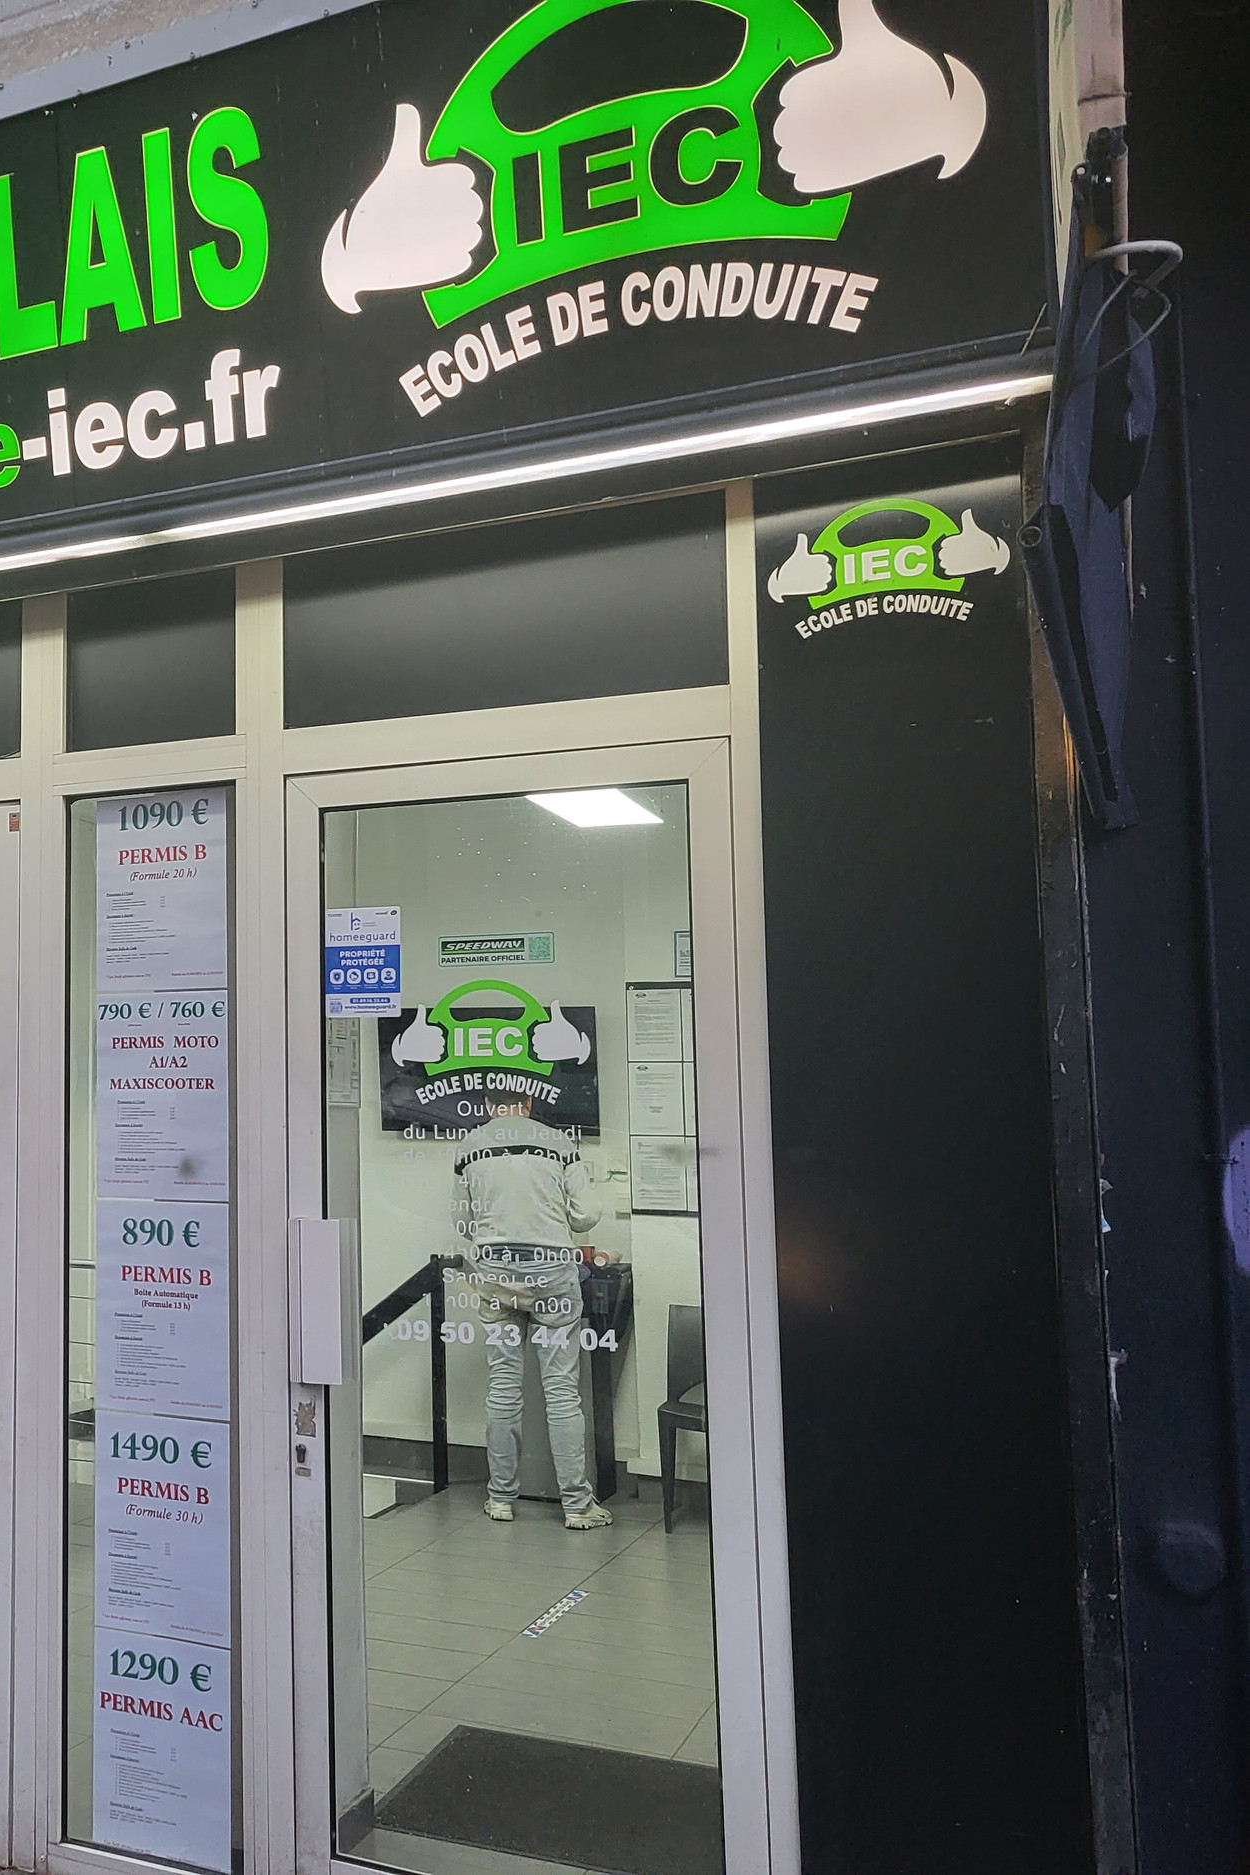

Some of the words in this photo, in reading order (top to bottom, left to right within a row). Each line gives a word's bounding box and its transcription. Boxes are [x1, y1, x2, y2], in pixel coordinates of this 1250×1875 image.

[512, 105, 743, 247] IEC
[398, 304, 543, 418] ECOLE
[546, 279, 609, 347] DE
[620, 262, 879, 333] CONDUITE
[843, 545, 928, 584] IEC
[794, 603, 854, 639] ECOLE
[856, 597, 878, 618] DE
[882, 594, 974, 622] CONDUITE
[118, 800, 183, 831] 1090
[191, 798, 209, 825] €
[118, 845, 188, 866] PERMIS
[195, 844, 207, 860] B
[130, 871, 170, 882] (Formule
[173, 869, 184, 879] 20
[186, 867, 197, 878] h)
[329, 930, 396, 943] homeeguard
[444, 940, 522, 951] SPEEDWAY
[340, 949, 386, 958] PROPRIÉTÉ
[341, 958, 385, 966] PROTÉGÉE
[441, 955, 489, 964] PARTENAIRE
[98, 1003, 132, 1020] 790
[138, 1002, 152, 1019] €
[170, 1001, 205, 1018] 760
[211, 1000, 226, 1018] €
[112, 1036, 164, 1049] PERMIS
[173, 1035, 219, 1048] MOTO
[453, 1026, 524, 1057] IEC
[149, 1055, 188, 1068] A1/A2
[110, 1078, 215, 1090] MAXISCOOTER
[415, 1075, 462, 1105] ECOLE
[465, 1073, 483, 1091] DE
[486, 1072, 562, 1105] CONDUITE
[457, 1100, 524, 1117] Ouvert
[403, 1125, 425, 1140] du
[434, 1124, 486, 1140] Lundi
[495, 1129, 519, 1140] au
[527, 1124, 582, 1140] Jeudi
[122, 1217, 174, 1246] 890
[182, 1220, 200, 1248] €
[121, 1265, 192, 1285] PERMIS
[199, 1269, 212, 1286] B
[153, 1289, 199, 1300] Automatique
[141, 1300, 173, 1310] (Formule
[174, 1301, 182, 1309] 13
[183, 1302, 191, 1311] h)
[398, 1319, 429, 1342] 09
[440, 1321, 475, 1344] 50
[485, 1323, 521, 1347] 23
[531, 1325, 570, 1349] 44
[580, 1328, 618, 1352] 04
[110, 1431, 180, 1464] 1490
[190, 1441, 212, 1469] €
[117, 1477, 189, 1502] PERMIS
[196, 1487, 210, 1505] B
[125, 1503, 172, 1520] (Formule
[175, 1510, 188, 1522] 30
[190, 1511, 204, 1525] h)
[109, 1648, 179, 1686] 1290
[189, 1663, 212, 1692] €
[99, 1690, 173, 1721] PERMIS
[179, 1706, 223, 1732] AAC
